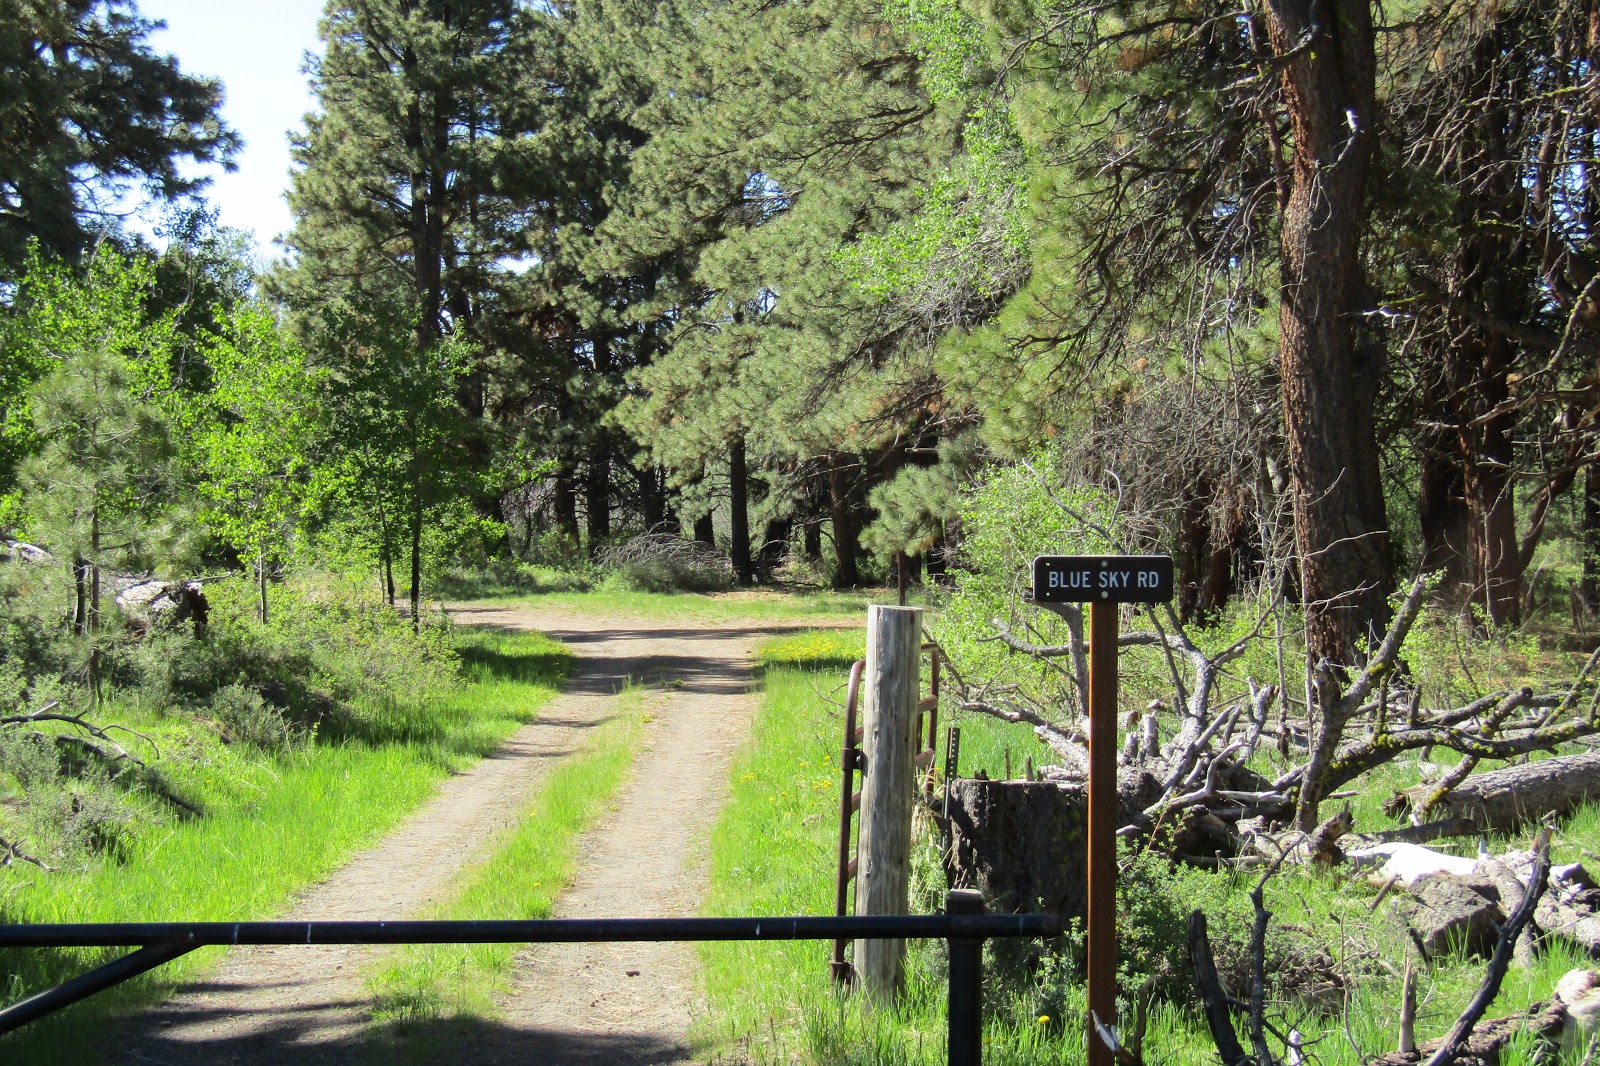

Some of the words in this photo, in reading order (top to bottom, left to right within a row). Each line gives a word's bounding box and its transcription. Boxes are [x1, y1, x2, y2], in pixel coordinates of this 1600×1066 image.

[1048, 571, 1092, 588] BLUE
[1098, 571, 1130, 588] SKY
[1137, 571, 1159, 588] RD
